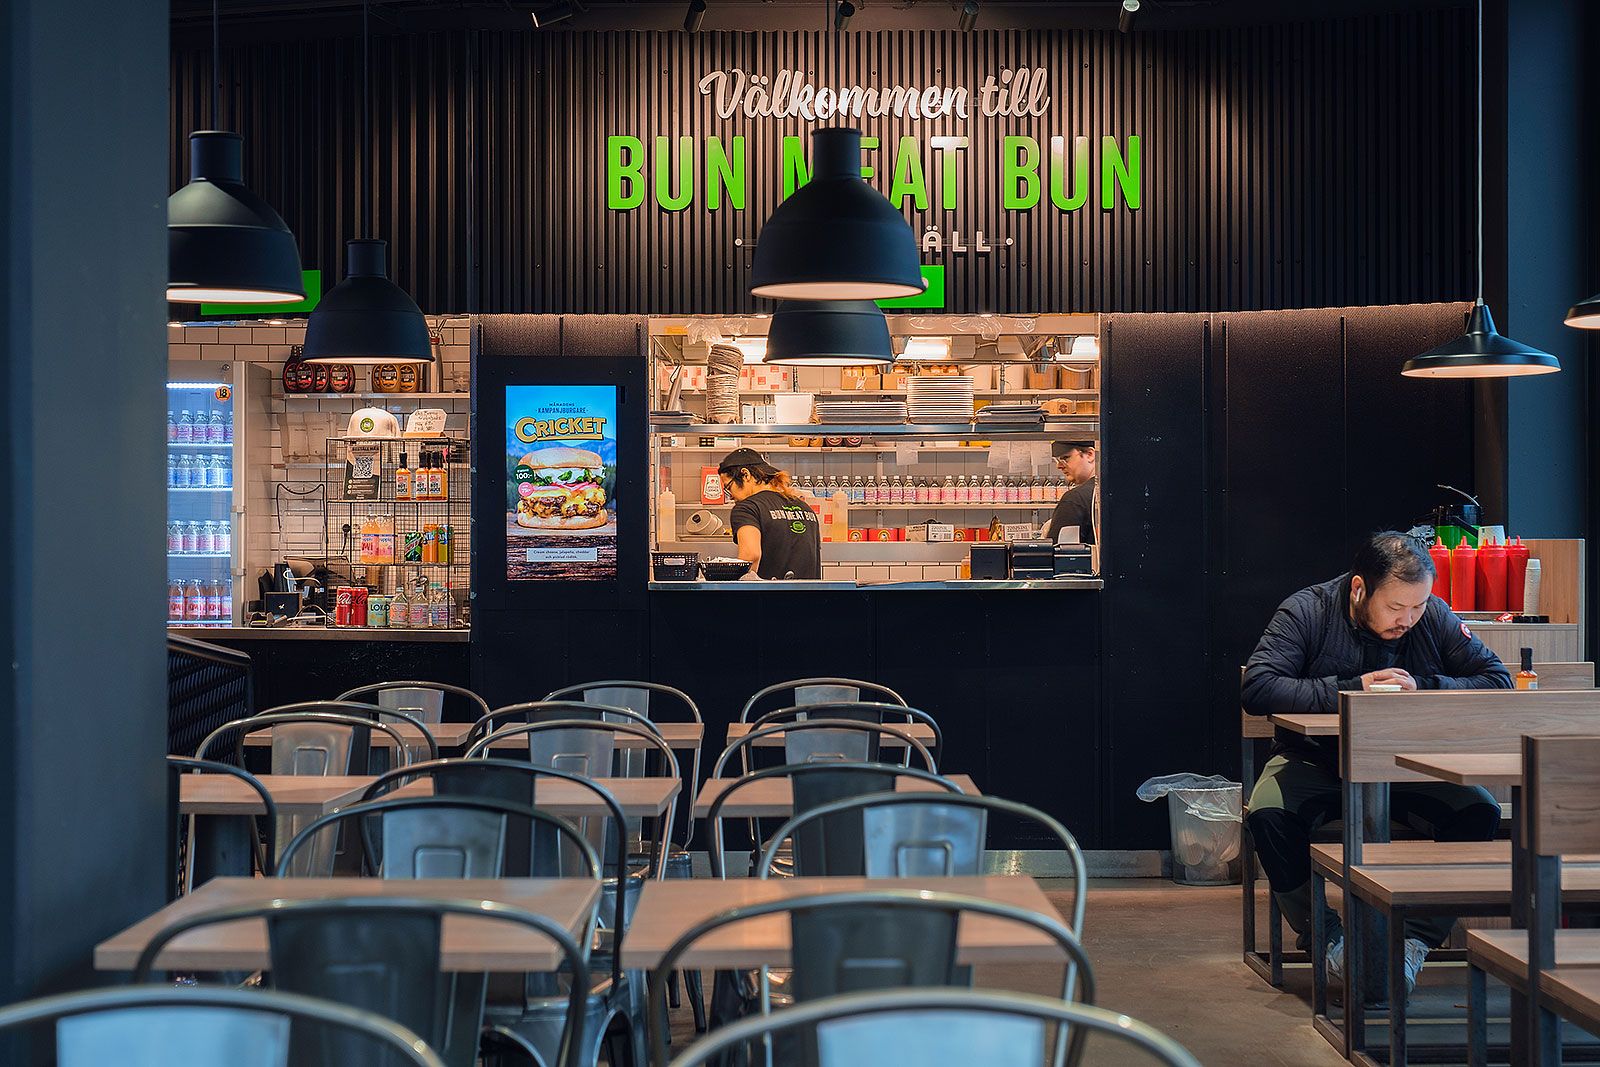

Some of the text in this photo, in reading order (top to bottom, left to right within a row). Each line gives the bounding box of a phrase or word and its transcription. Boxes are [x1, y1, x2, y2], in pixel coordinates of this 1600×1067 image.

[699, 67, 1050, 119] Välkommen till
[608, 135, 745, 210] BUN
[1004, 135, 1140, 211] BUN
[515, 417, 607, 443] CRICKET
[786, 510, 805, 520] MEAT
